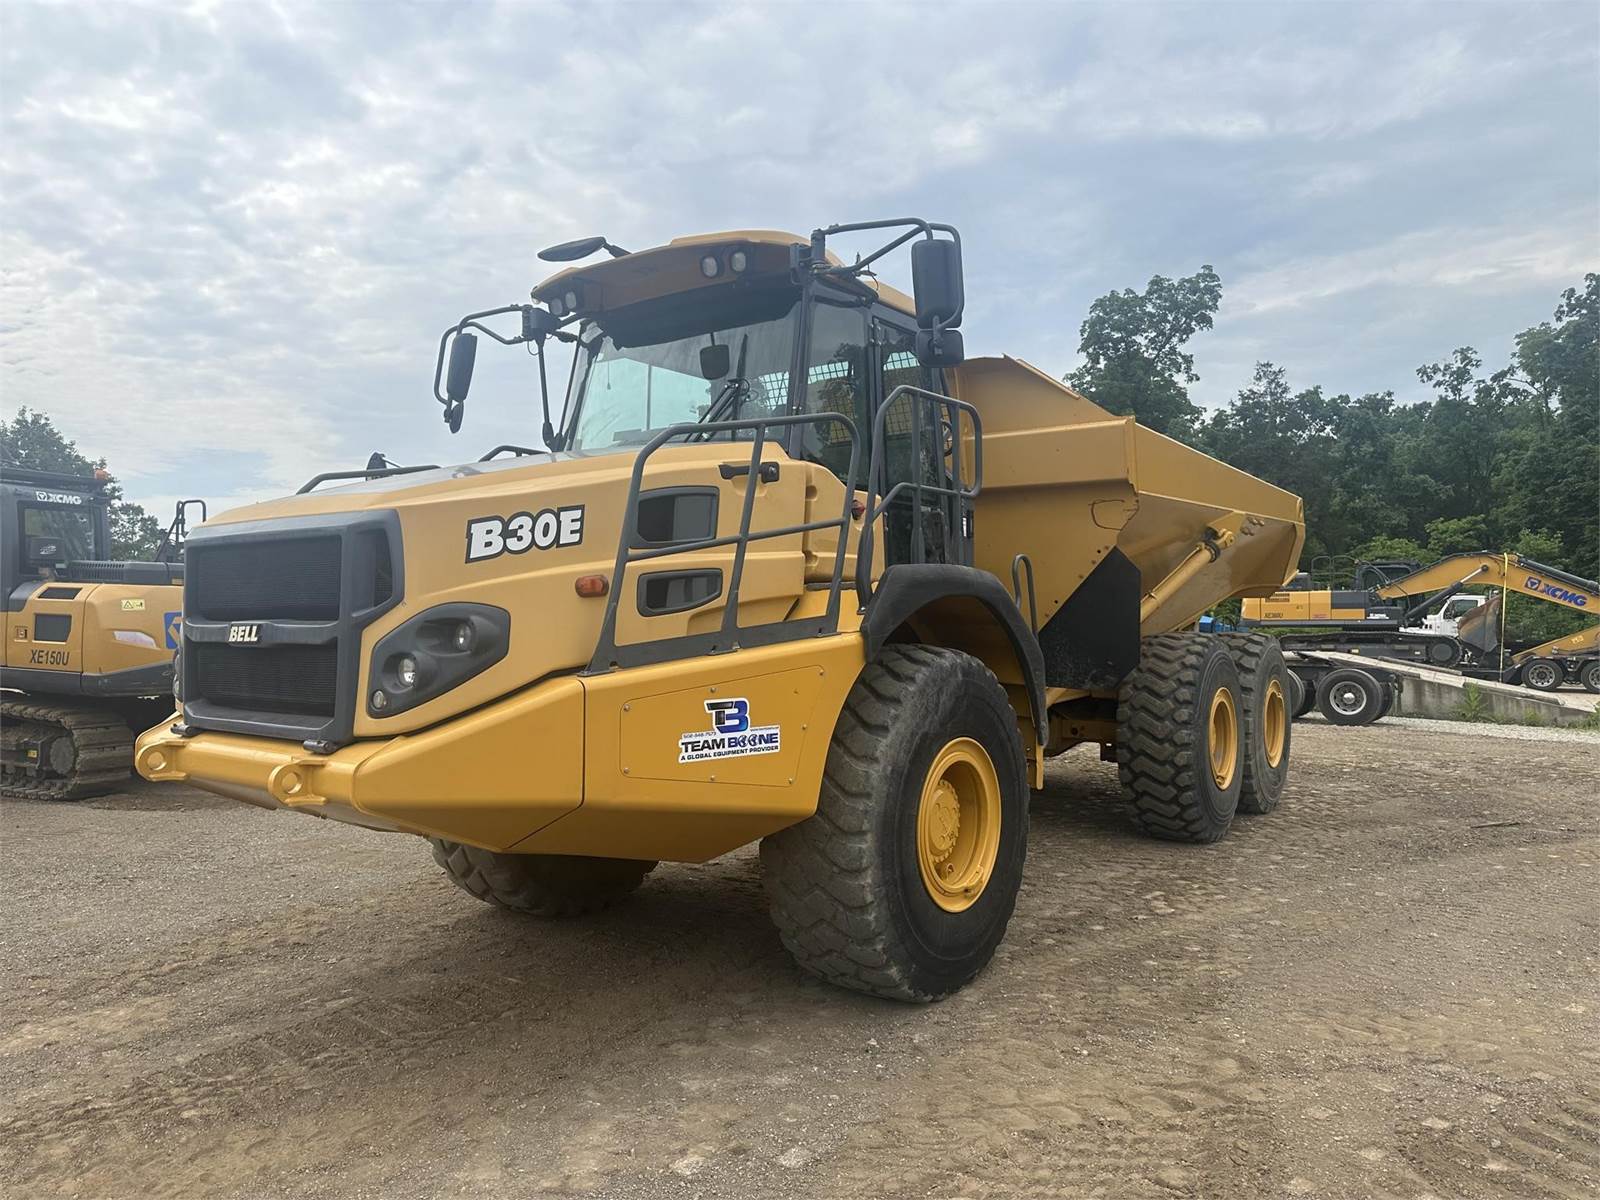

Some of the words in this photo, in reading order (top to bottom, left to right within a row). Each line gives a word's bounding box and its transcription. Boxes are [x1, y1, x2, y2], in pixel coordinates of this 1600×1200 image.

[48, 492, 82, 505] XCMG
[465, 504, 585, 564] B30E
[1543, 583, 1588, 607] XCMG
[228, 625, 258, 642] BELL
[30, 649, 70, 666] XE150U
[681, 738, 726, 753] TEAM
[727, 733, 779, 748] BOONE
[687, 752, 712, 760] GLOBAL
[713, 748, 748, 757] EQUIPMENT
[749, 745, 779, 753] PROVIDER
